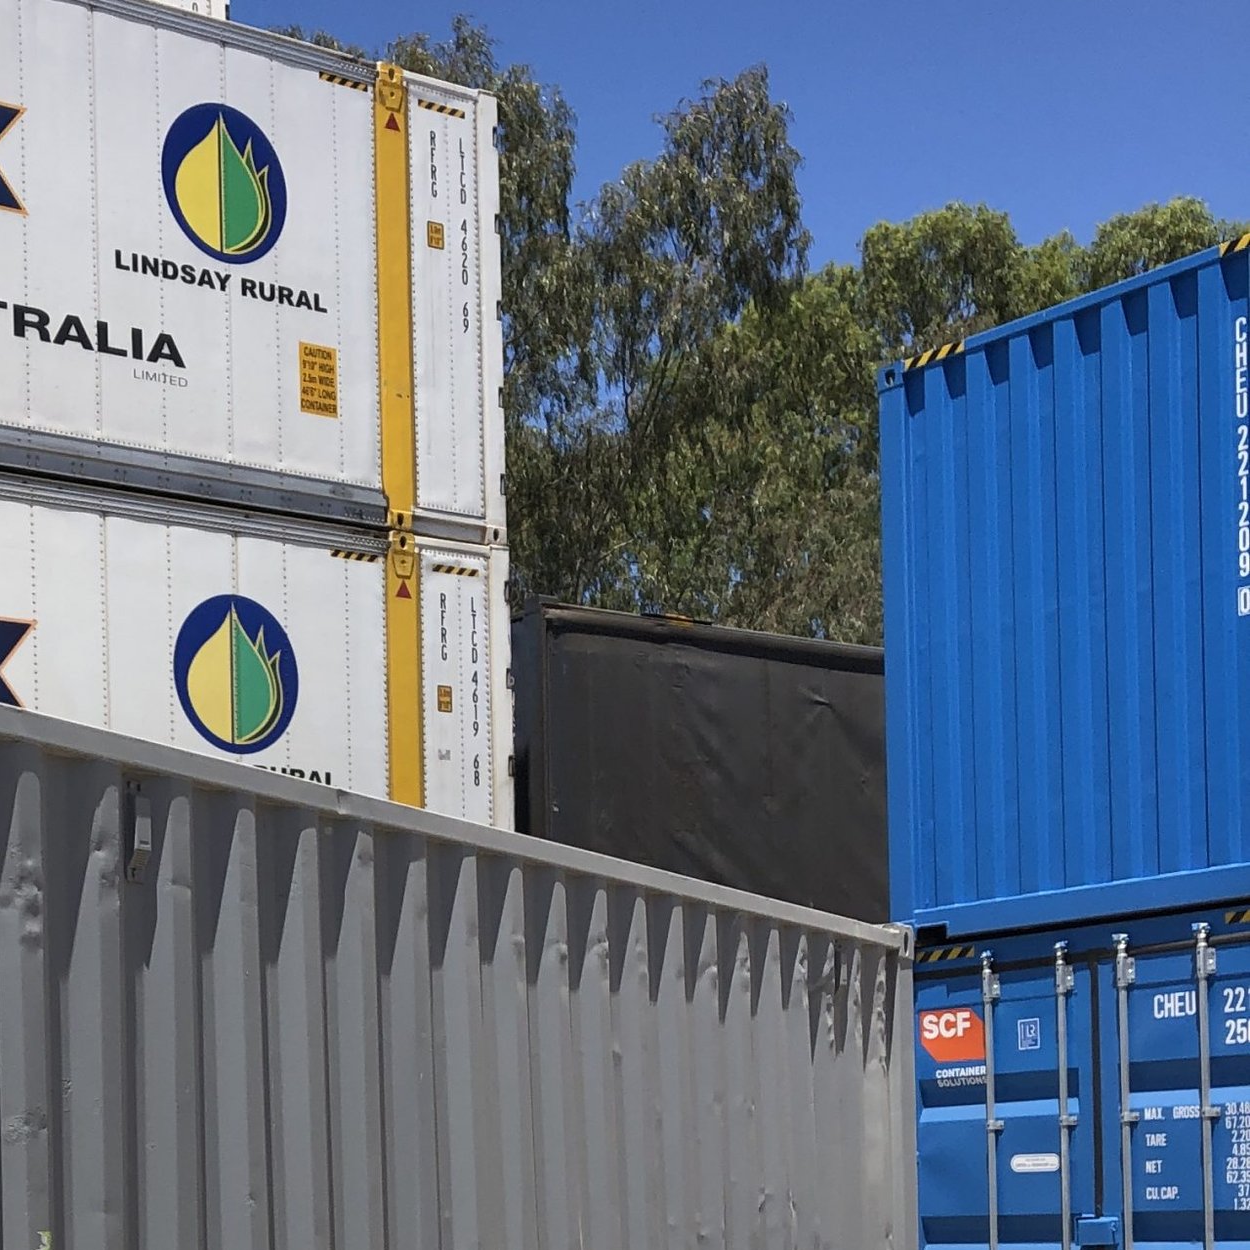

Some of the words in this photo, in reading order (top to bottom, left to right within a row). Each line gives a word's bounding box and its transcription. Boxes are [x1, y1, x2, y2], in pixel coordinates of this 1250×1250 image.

[430, 130, 438, 199] RFRG
[459, 137, 467, 205] LTCD
[460, 219, 469, 285] 4620
[115, 249, 231, 292] LINDSAY
[241, 277, 328, 313] RURAL
[303, 346, 332, 361] CAUTION
[1235, 316, 1248, 418] CHEU
[133, 368, 188, 387] LIMITED
[301, 398, 337, 414] CONTAINER
[1237, 424, 1250, 578] 221209
[471, 670, 479, 737] 4619
[1153, 990, 1197, 1019] CHEU
[922, 1011, 971, 1040] SCF
[935, 1065, 987, 1079] CONTAINER
[1144, 1107, 1165, 1120] MAX.
[1172, 1105, 1200, 1119] GROSS
[1145, 1133, 1167, 1147] TARE
[1145, 1160, 1162, 1173] NET
